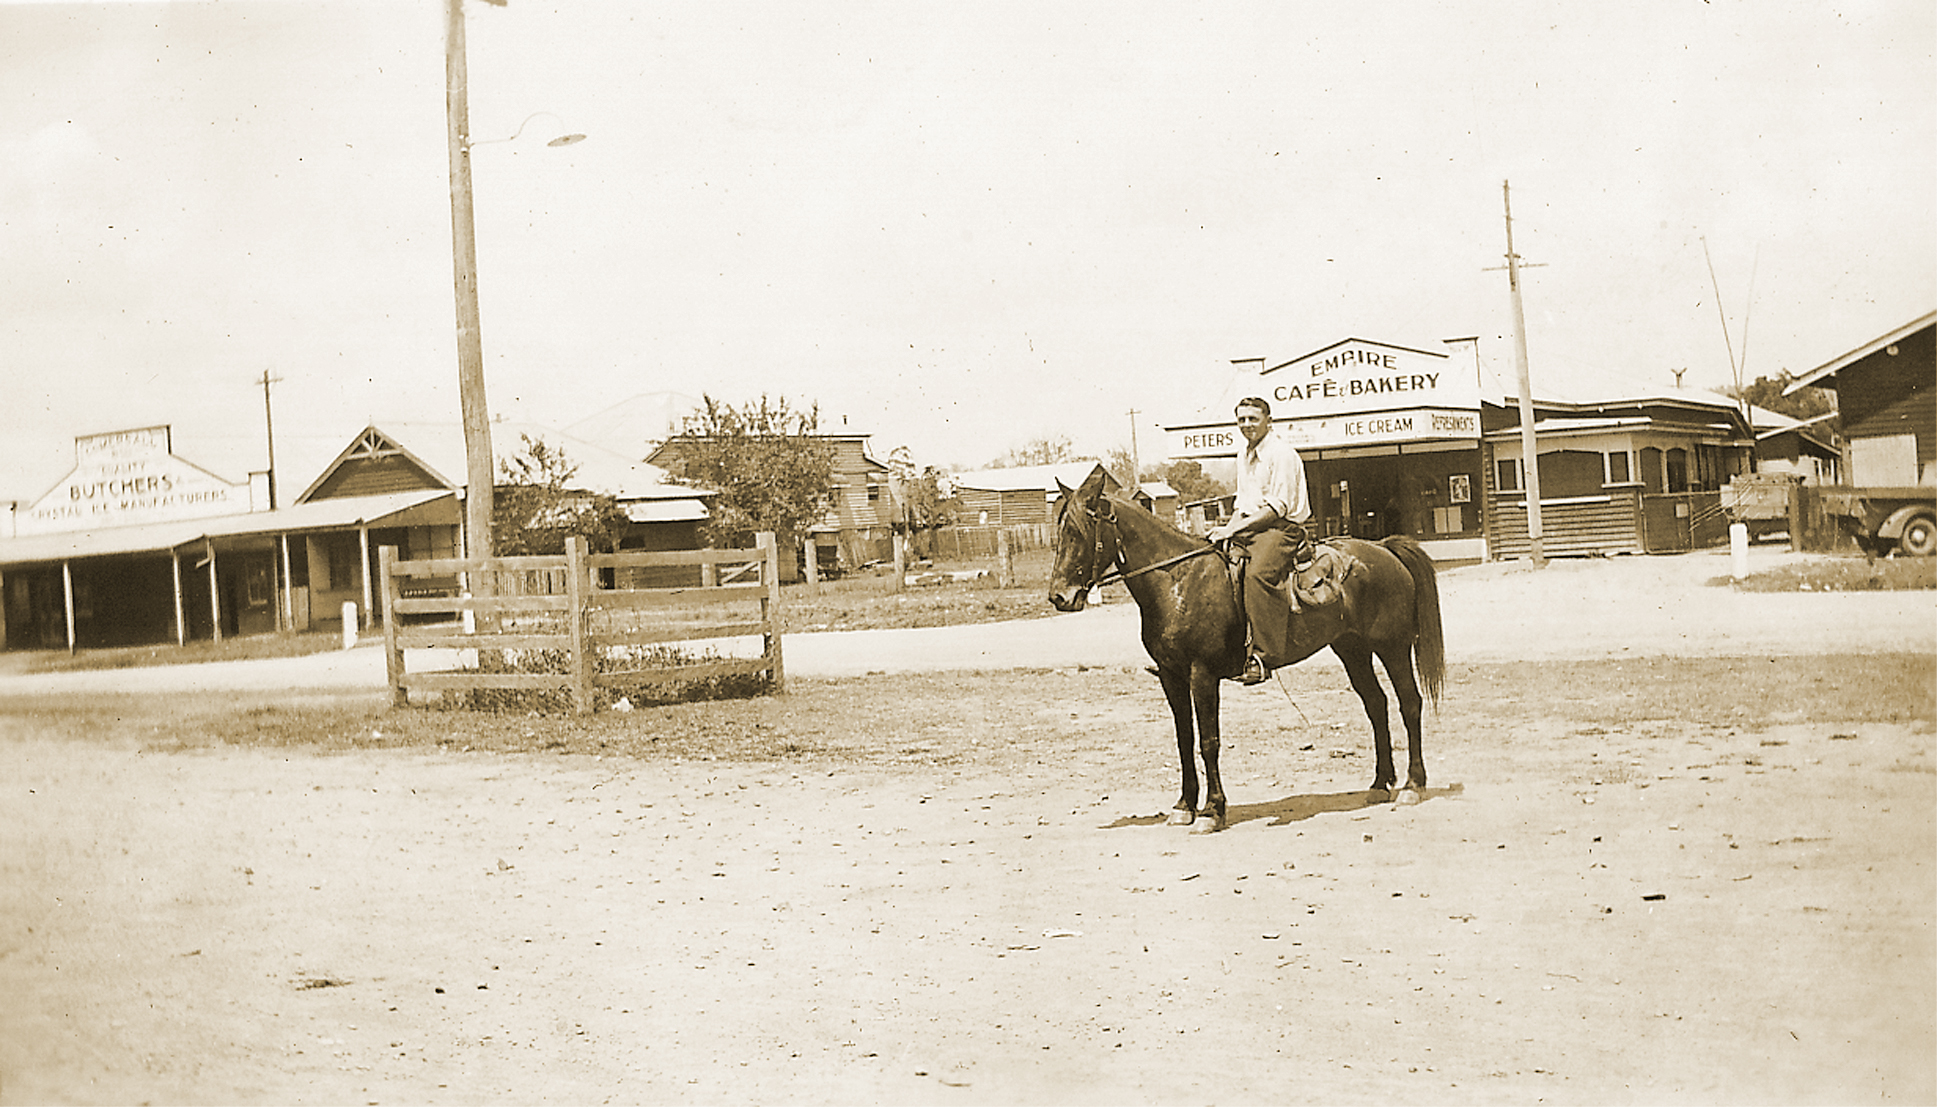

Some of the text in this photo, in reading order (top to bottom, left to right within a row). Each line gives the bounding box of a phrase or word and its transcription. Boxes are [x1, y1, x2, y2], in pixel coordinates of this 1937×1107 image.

[1311, 350, 1397, 377] EMPIRE
[1350, 372, 1440, 396] BAKERY
[1184, 418, 1413, 449] PETERS ICE CREAM
[69, 474, 173, 502] BUTCHERS
